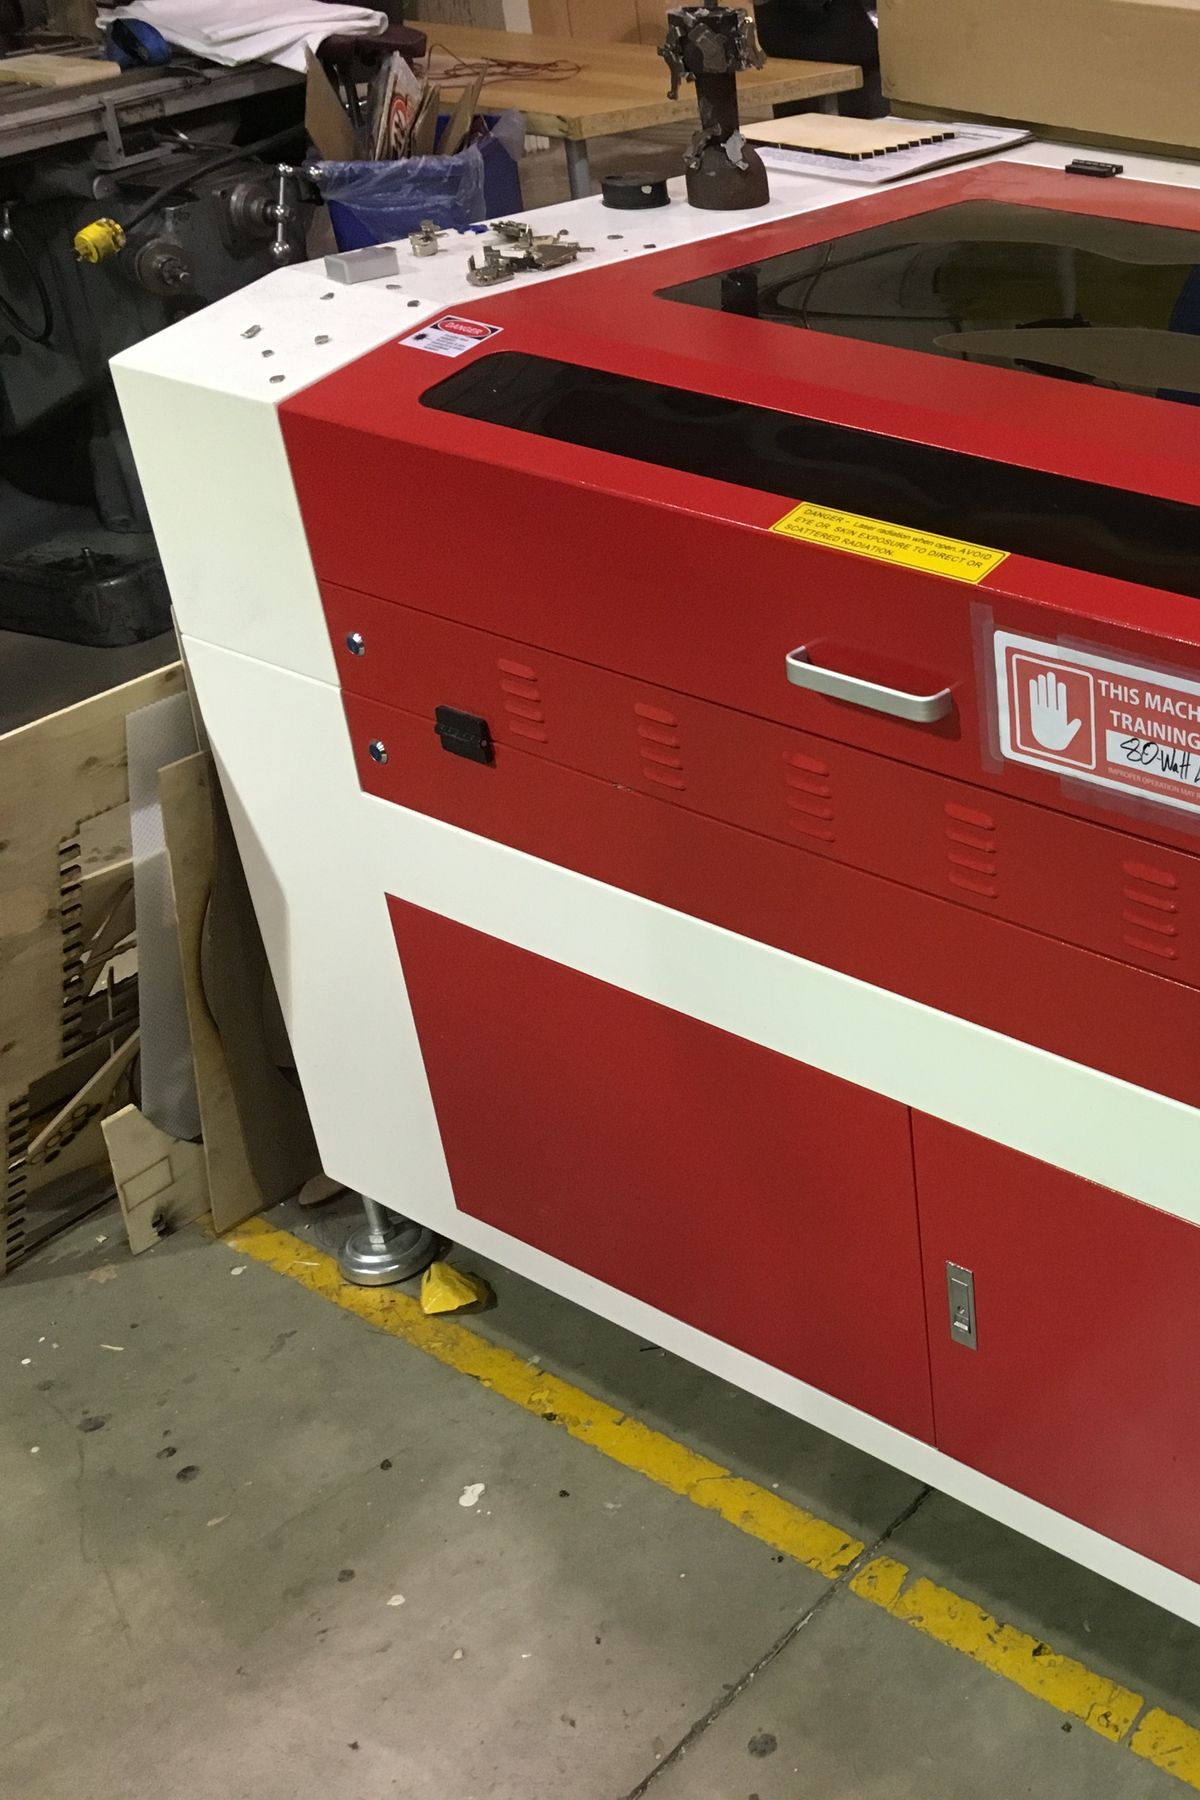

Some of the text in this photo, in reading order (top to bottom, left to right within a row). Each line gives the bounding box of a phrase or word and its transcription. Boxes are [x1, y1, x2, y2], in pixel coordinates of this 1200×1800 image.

[784, 523, 841, 542] SCATTERED
[794, 516, 815, 526] EYE
[834, 526, 857, 536] SKIN
[858, 532, 912, 550] EXPOSURE
[913, 546, 927, 554] TO
[928, 550, 967, 564] DIRECT
[966, 560, 983, 568] OR
[803, 509, 844, 522] DANGER
[853, 522, 877, 531] Laser
[912, 537, 934, 546] when
[959, 548, 993, 560] AVOID
[1097, 679, 1140, 705] THIS
[1109, 709, 1200, 750] TRAINING
[1107, 767, 1141, 781] IMPROPER
[1142, 776, 1182, 792] OPERATION
[1181, 787, 1196, 798] MAY
